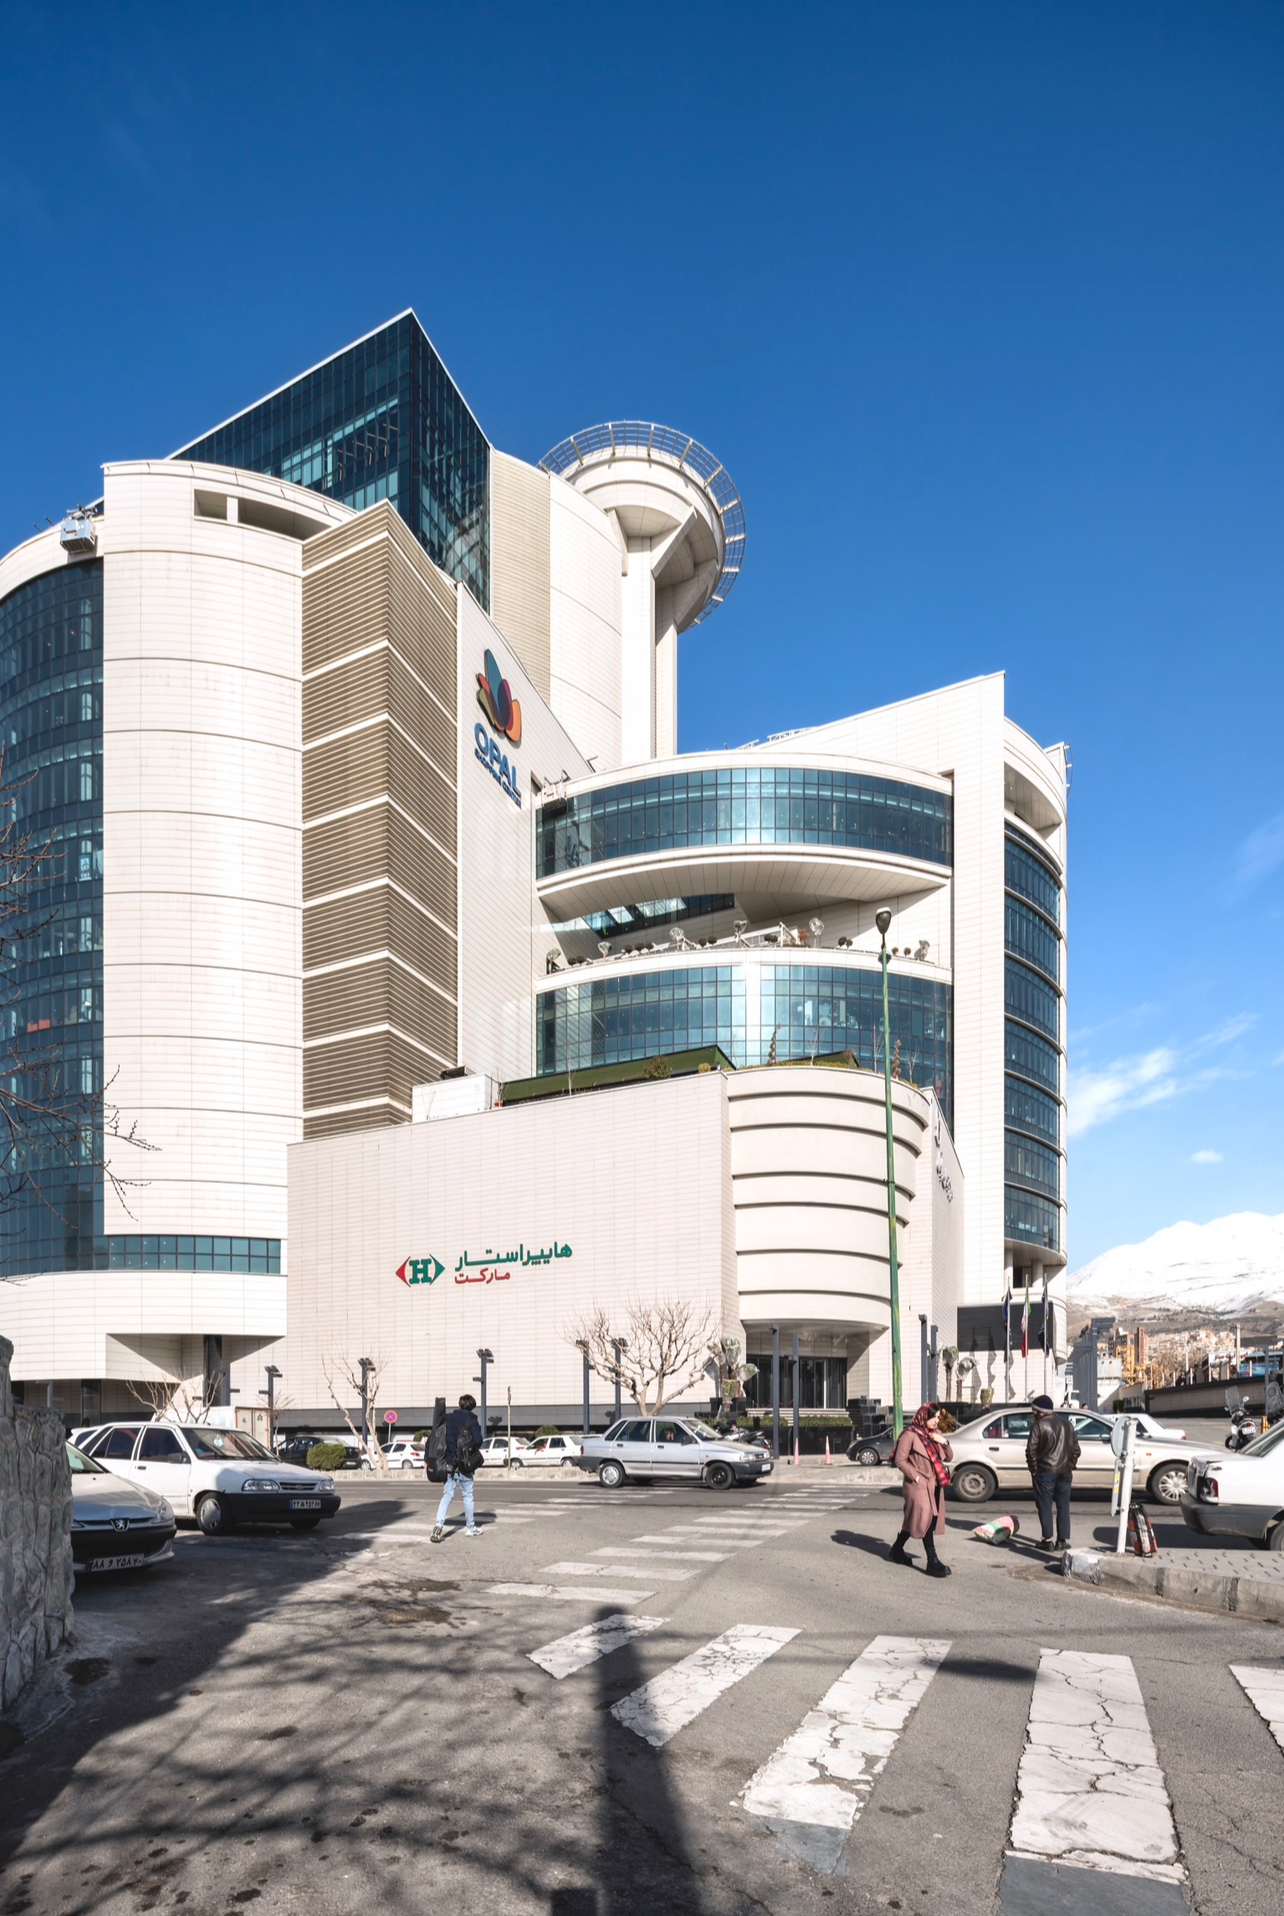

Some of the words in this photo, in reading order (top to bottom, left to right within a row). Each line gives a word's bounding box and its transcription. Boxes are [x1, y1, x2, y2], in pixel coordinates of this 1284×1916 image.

[474, 722, 521, 798] OPAL
[455, 1241, 573, 1272] هایپراستار
[408, 1259, 433, 1285] H
[454, 1267, 511, 1285] مارکت
